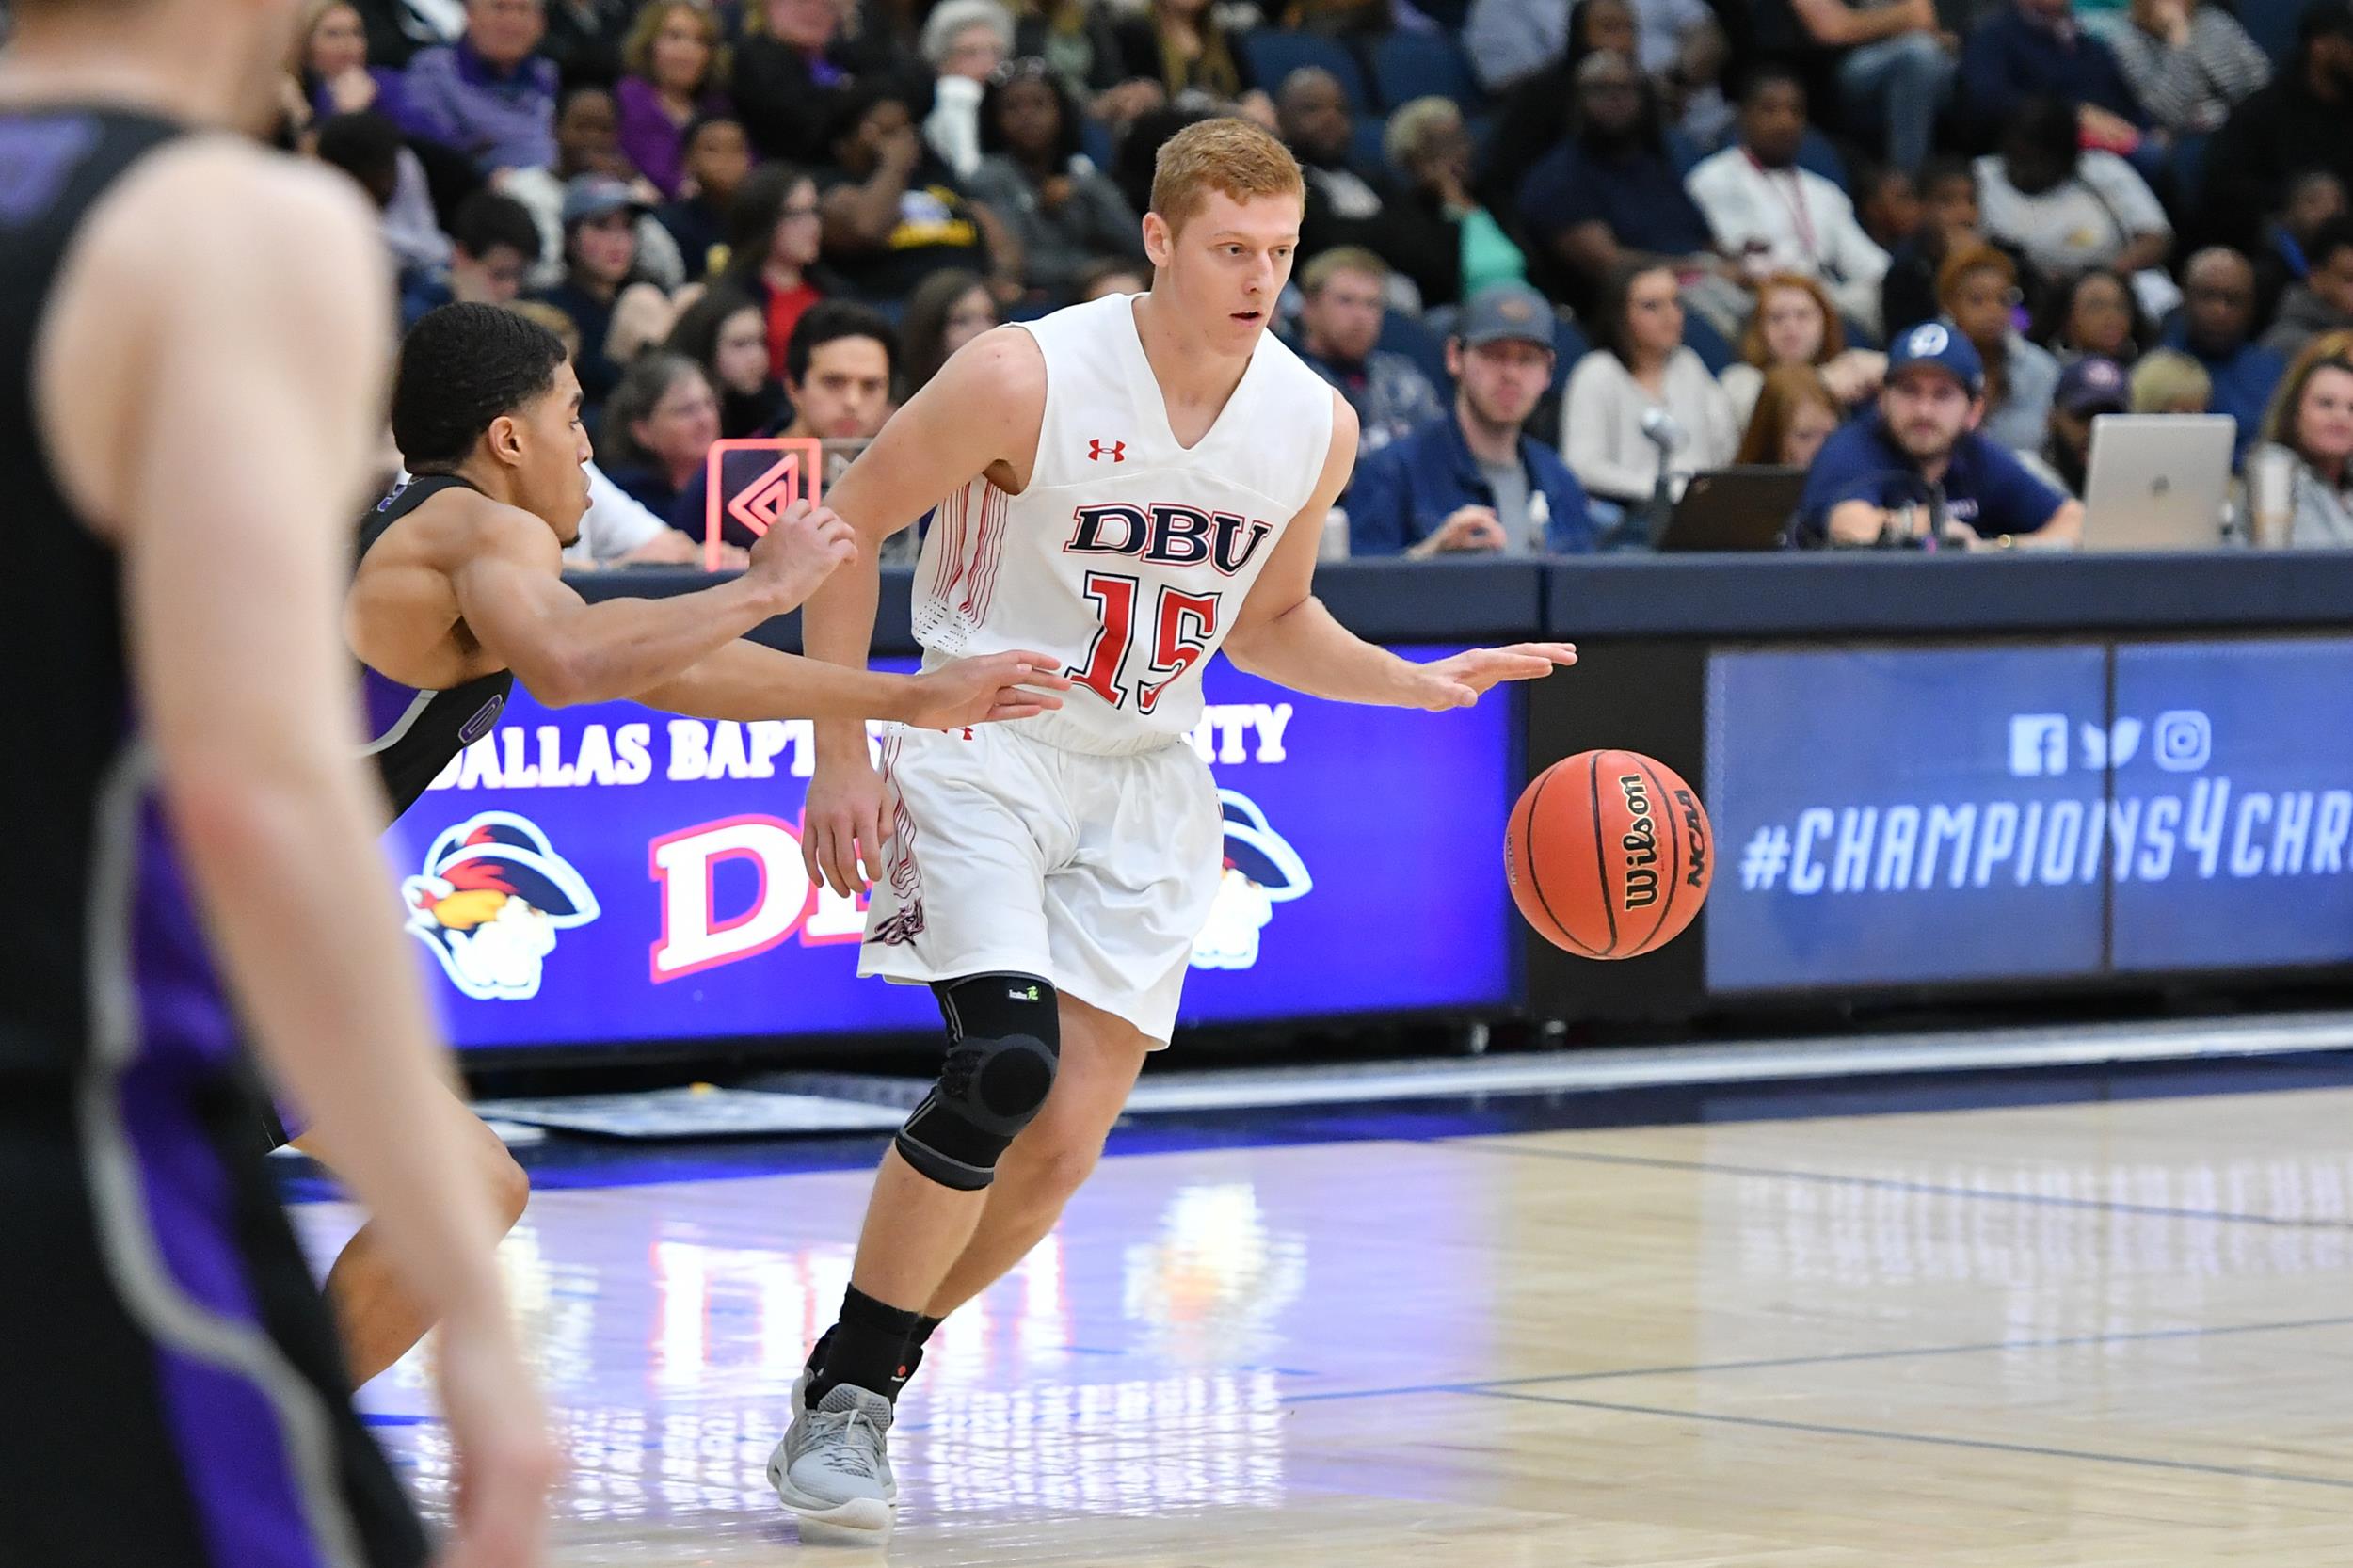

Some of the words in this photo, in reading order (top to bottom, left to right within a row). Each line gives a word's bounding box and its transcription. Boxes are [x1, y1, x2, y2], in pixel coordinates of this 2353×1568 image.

[1063, 503, 1273, 577] DBU
[1064, 569, 1223, 715] 15
[667, 718, 881, 781] BAPT
[1619, 773, 1660, 912] Wilson
[1673, 789, 1705, 888] NCAA
[1741, 776, 2353, 894] #CHAMPIONS4CHR
